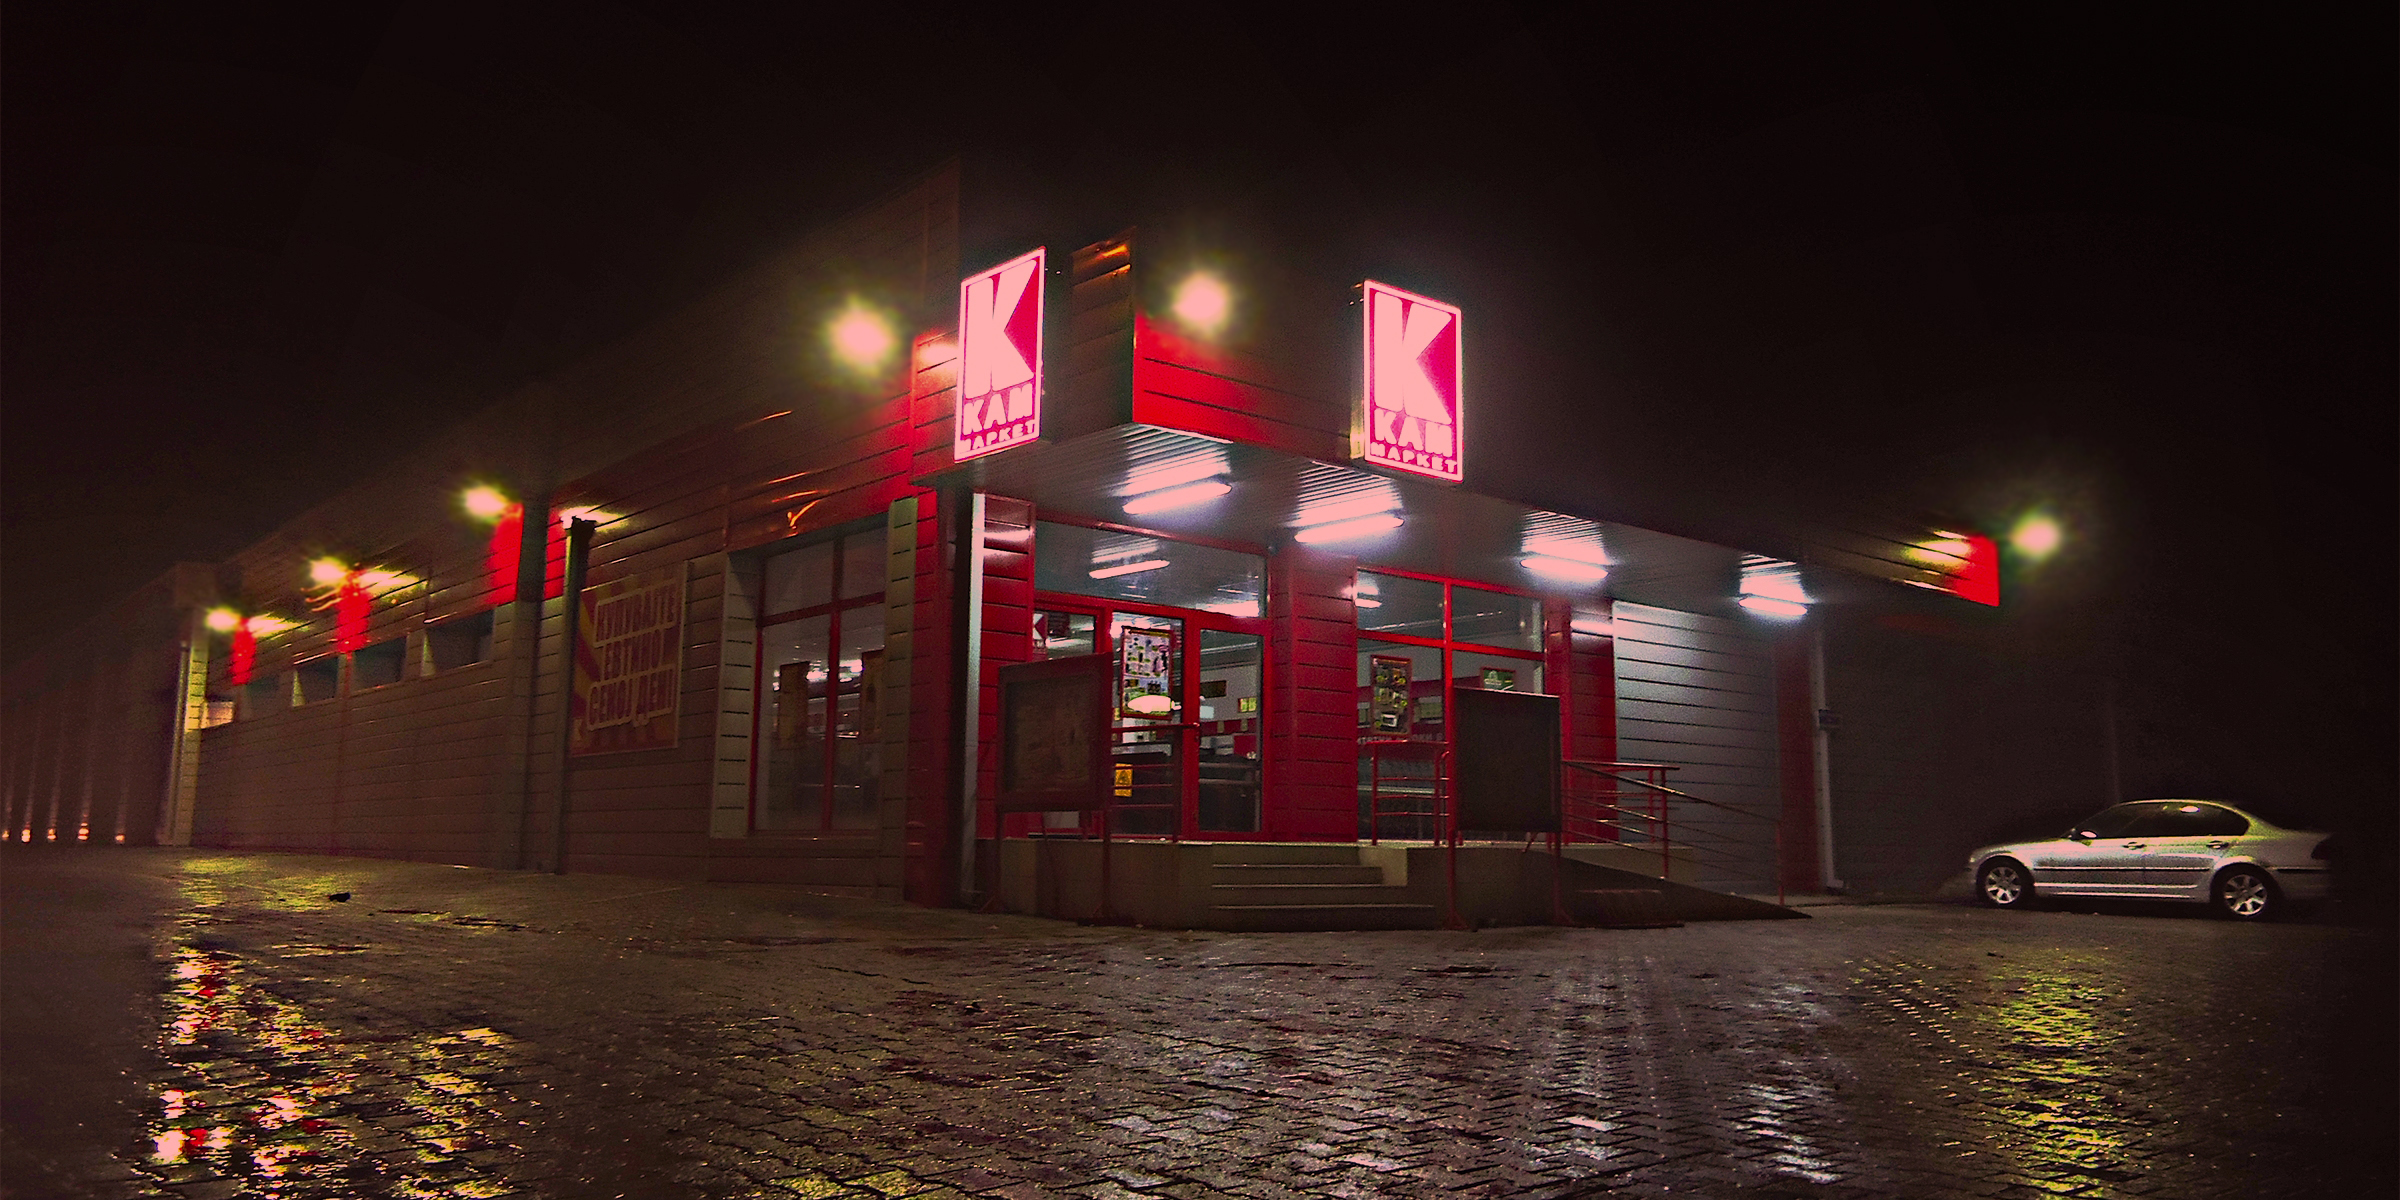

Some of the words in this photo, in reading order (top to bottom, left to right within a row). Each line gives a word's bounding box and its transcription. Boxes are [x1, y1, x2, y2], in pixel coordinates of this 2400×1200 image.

[963, 383, 1033, 436] КАМ
[1374, 408, 1453, 458] КАМ
[1370, 442, 1458, 473] МАРКЕТ
